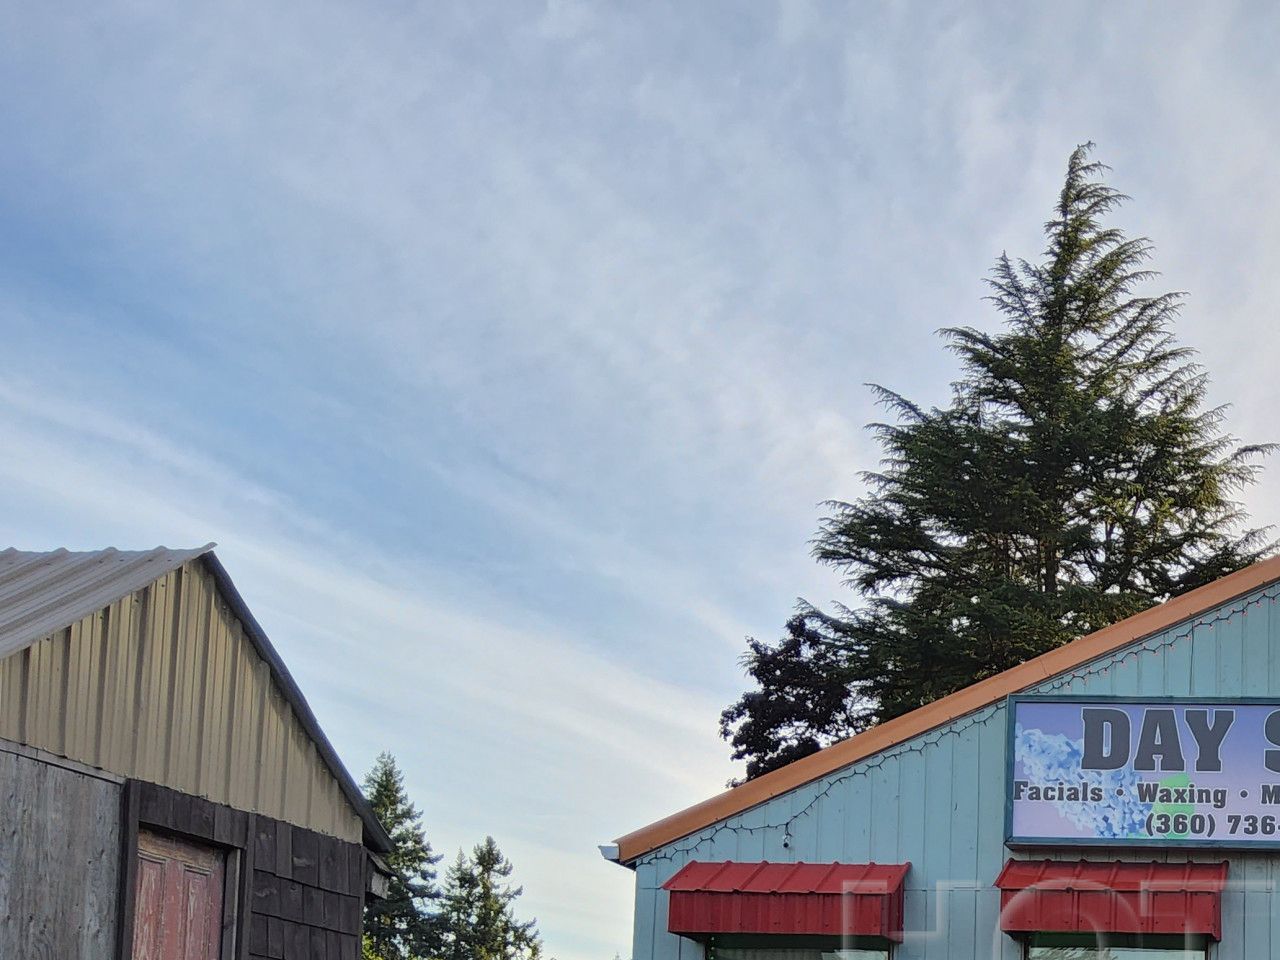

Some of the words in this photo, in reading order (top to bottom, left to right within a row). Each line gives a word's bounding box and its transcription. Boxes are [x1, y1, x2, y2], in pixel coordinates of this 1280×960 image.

[1080, 706, 1236, 773] DAY
[1013, 780, 1104, 804] Facials
[1137, 782, 1228, 808] Waxing
[1145, 813, 1216, 837] (360)
